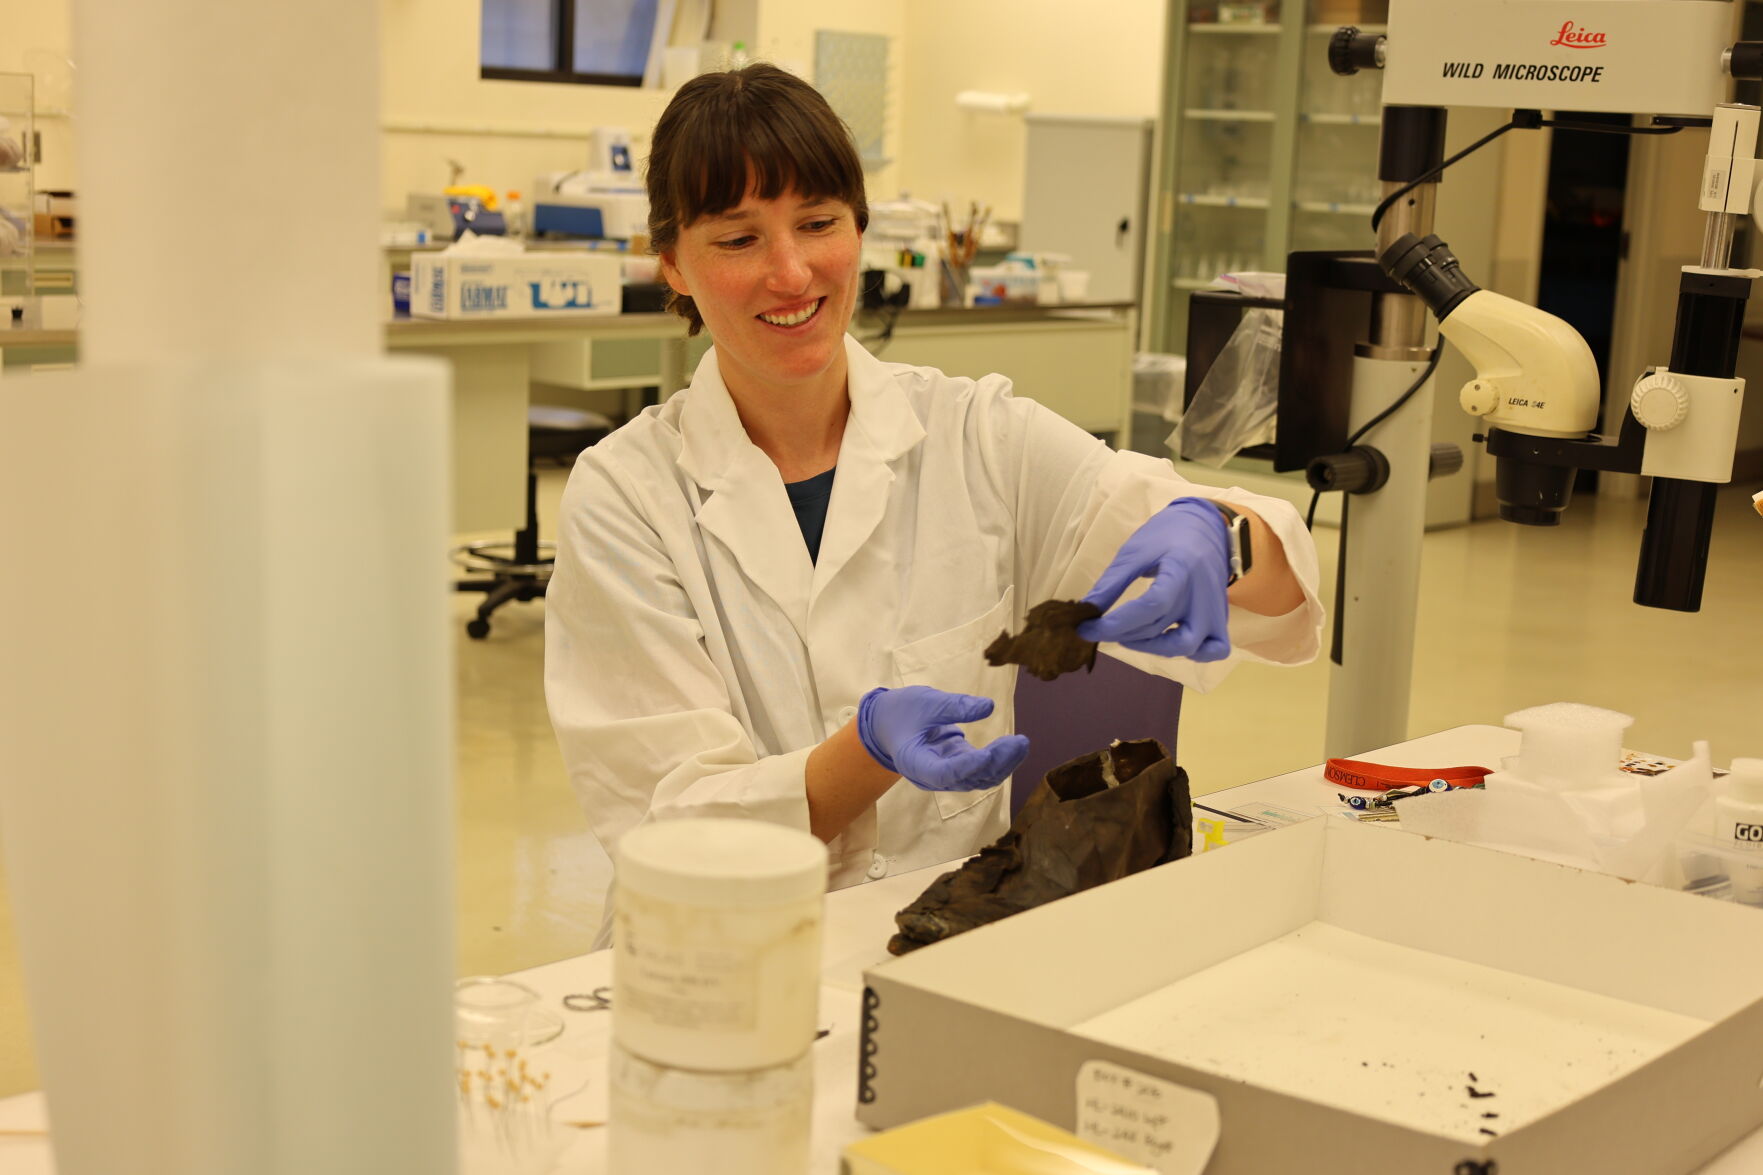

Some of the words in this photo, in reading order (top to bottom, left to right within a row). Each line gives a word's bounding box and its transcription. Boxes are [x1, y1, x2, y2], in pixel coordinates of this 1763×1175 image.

[1550, 20, 1607, 49] Leica
[1442, 62, 1484, 79] WILD
[1492, 63, 1604, 83] MICROSCOPE
[1508, 397, 1529, 408] LEICA
[1736, 823, 1763, 841] GO
